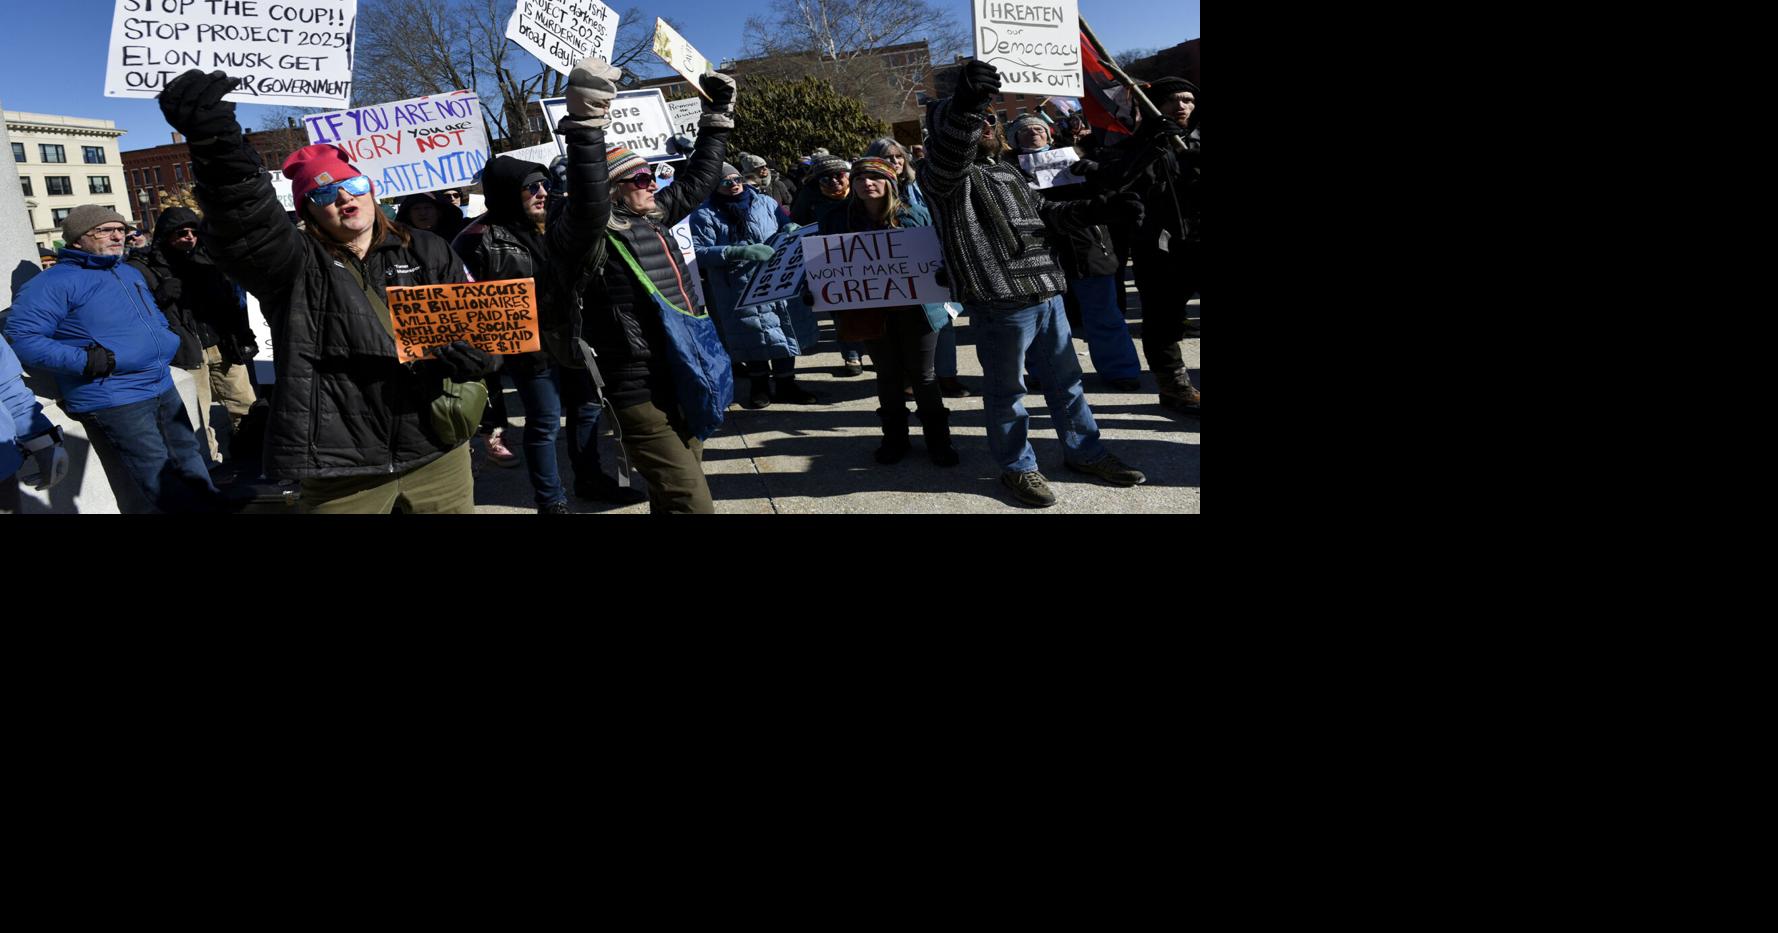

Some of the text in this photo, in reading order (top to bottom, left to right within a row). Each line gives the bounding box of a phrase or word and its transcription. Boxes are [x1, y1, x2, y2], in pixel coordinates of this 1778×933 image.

[205, 0, 259, 17] THE
[269, 5, 345, 26] COUP!!
[124, 18, 190, 41] STOP
[197, 24, 297, 45] PROJECT
[519, 14, 546, 49] broad
[524, 1, 533, 16] IS
[535, 10, 588, 52] MURDERING
[570, 18, 604, 48] 2025
[122, 46, 329, 71] ELON MUSK GET
[980, 26, 1079, 66] Democracy
[125, 71, 352, 98] OUT UR GOVERNMENT
[305, 96, 478, 145] IF YOU ARE NOT
[611, 106, 641, 119] ere
[407, 120, 473, 138] you are
[612, 121, 644, 135] Our
[680, 122, 697, 138] 14
[338, 130, 466, 163] NGRY NOT
[822, 230, 909, 264] HATE
[752, 234, 799, 299] Resist!
[863, 261, 910, 276] MAKE
[918, 259, 939, 274] US
[390, 287, 448, 302] THEIR
[821, 275, 920, 305] GREAT
[392, 296, 530, 315] FOR BILLIONAIRES
[396, 309, 532, 327] WILL BE PAID FOR
[396, 321, 526, 337] WITH OUR SOCIAL
[470, 330, 534, 343] MEDICAID
